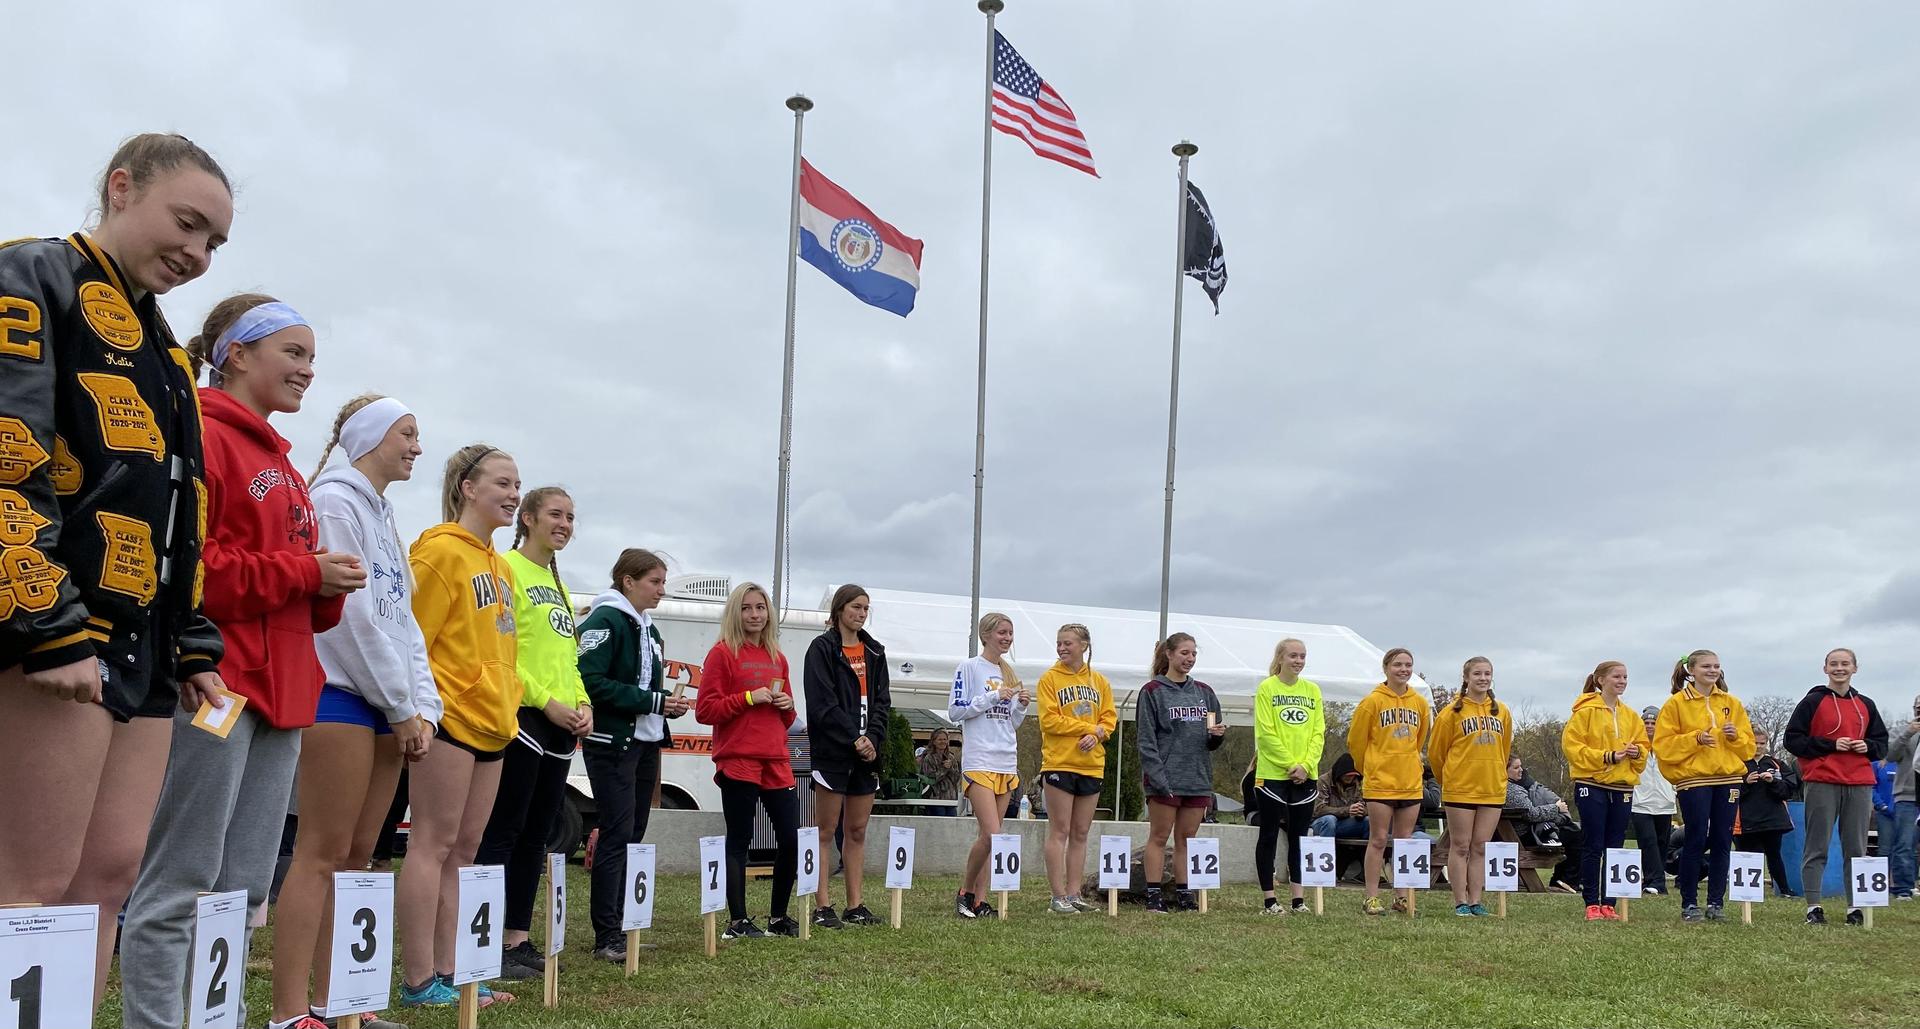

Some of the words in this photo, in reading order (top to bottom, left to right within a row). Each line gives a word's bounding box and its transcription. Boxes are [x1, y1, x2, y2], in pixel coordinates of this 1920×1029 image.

[95, 308, 107, 318] ALL
[0, 296, 41, 359] 2
[104, 352, 135, 368] Katie
[109, 396, 132, 406] CLASS
[107, 407, 121, 416] ALL
[123, 409, 146, 419] STATE
[109, 418, 148, 430] 2020-2021
[115, 531, 138, 544] CLASS
[115, 554, 128, 564] ALL
[120, 544, 136, 555] DIST.
[16, 570, 51, 583] 2020-2021
[472, 573, 498, 610] VAN
[1057, 686, 1076, 707] VAN
[1169, 706, 1208, 719] INDIANS
[1286, 709, 1304, 722] XC
[1380, 708, 1397, 728] VAN
[1461, 716, 1479, 736] VAN
[1579, 787, 1589, 797] 20
[1728, 788, 1740, 803] P
[804, 848, 814, 876] 8
[895, 846, 907, 871] 9
[994, 852, 1020, 875] 10
[1103, 852, 1128, 874] 11
[1191, 853, 1218, 875] 12
[1305, 852, 1335, 873] 13
[1398, 854, 1429, 874] 14
[1488, 857, 1517, 877] 15
[708, 860, 719, 891] 7
[1610, 863, 1640, 884] 16
[1733, 867, 1762, 888] 17
[1856, 872, 1887, 893] 18
[634, 870, 647, 905] 6
[556, 885, 563, 925] 5
[470, 901, 491, 948] 4
[350, 907, 377, 964] 3
[205, 937, 229, 1010] 2
[11, 965, 43, 1029] 1
